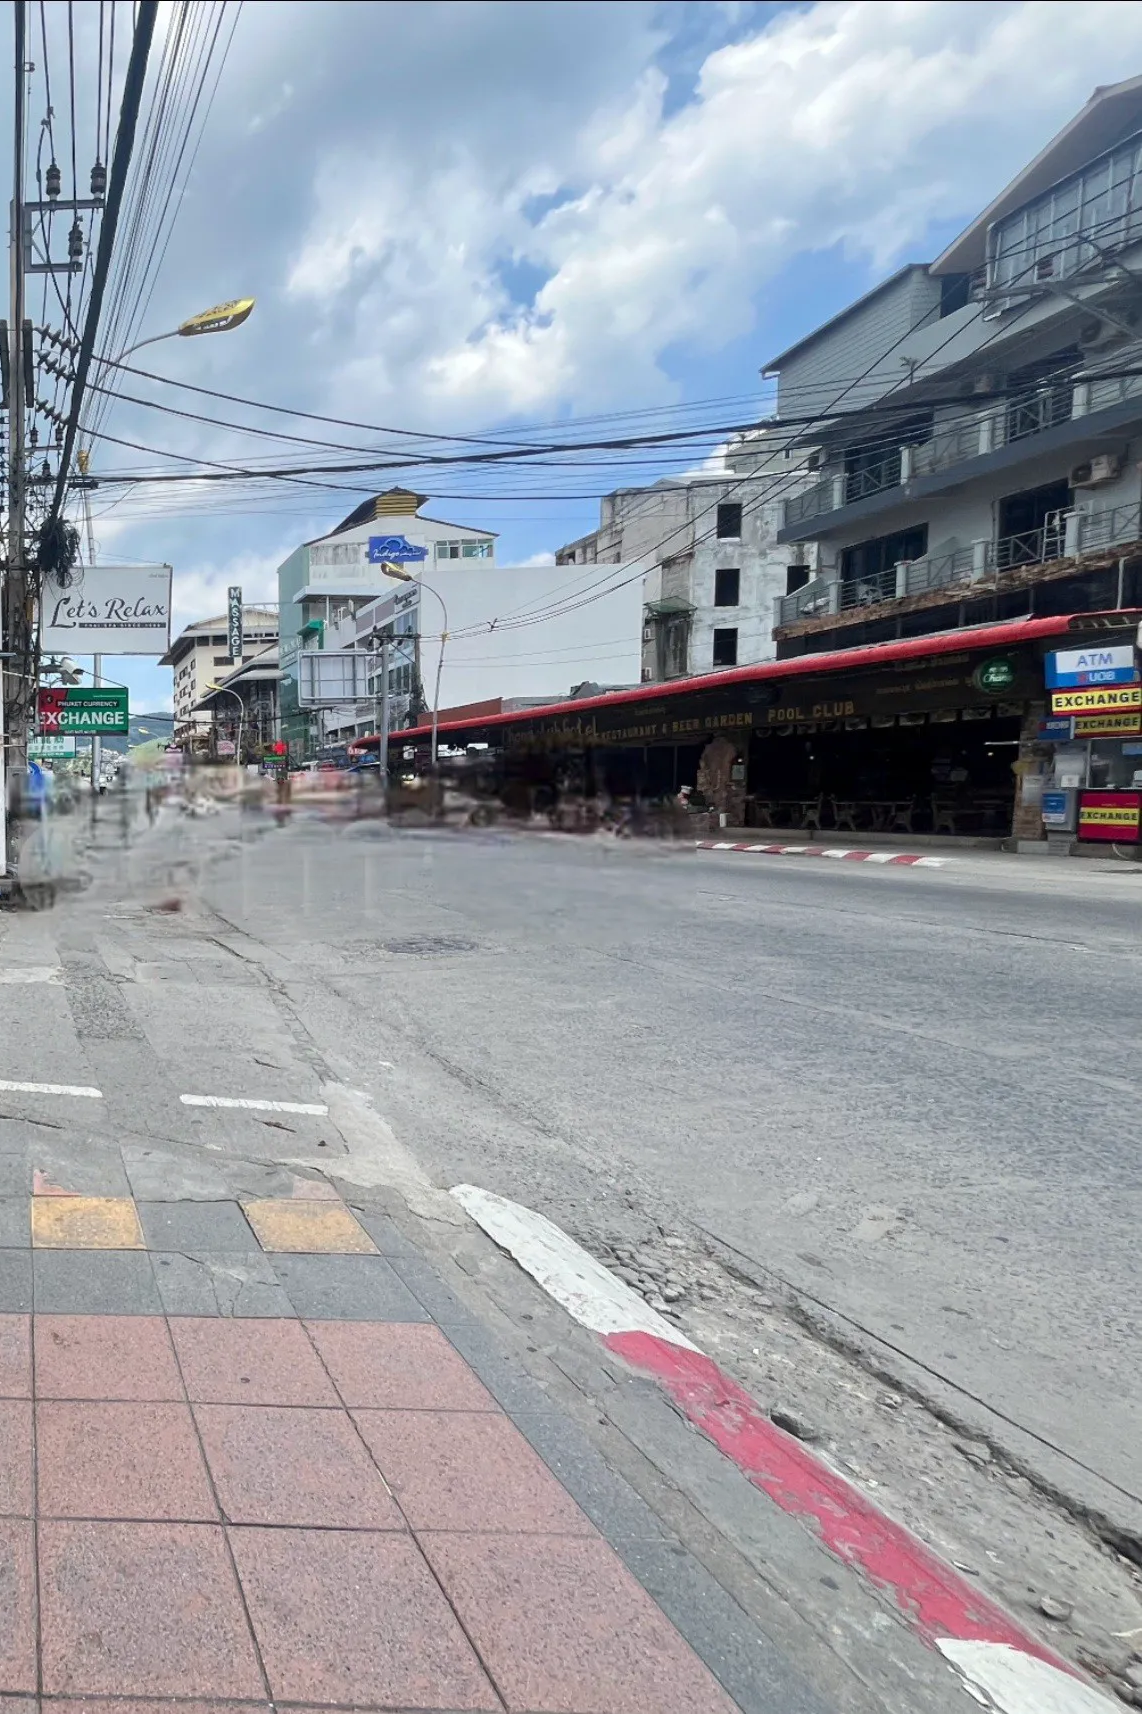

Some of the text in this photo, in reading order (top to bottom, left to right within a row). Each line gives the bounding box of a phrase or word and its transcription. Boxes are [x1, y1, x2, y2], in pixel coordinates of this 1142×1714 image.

[46, 596, 168, 628] Let's Relax
[230, 588, 240, 656] MASSAGE
[1077, 652, 1113, 667] ATM
[1088, 671, 1115, 681] UOB
[1055, 691, 1142, 708] EXCHANGE
[40, 711, 124, 725] EXCHANGE
[767, 700, 855, 723] POOL CLUB
[672, 718, 700, 733] BEER
[705, 712, 753, 729] GARDEN
[1075, 717, 1138, 730] EXCHANGE
[1081, 811, 1138, 821] EXCHANGE
